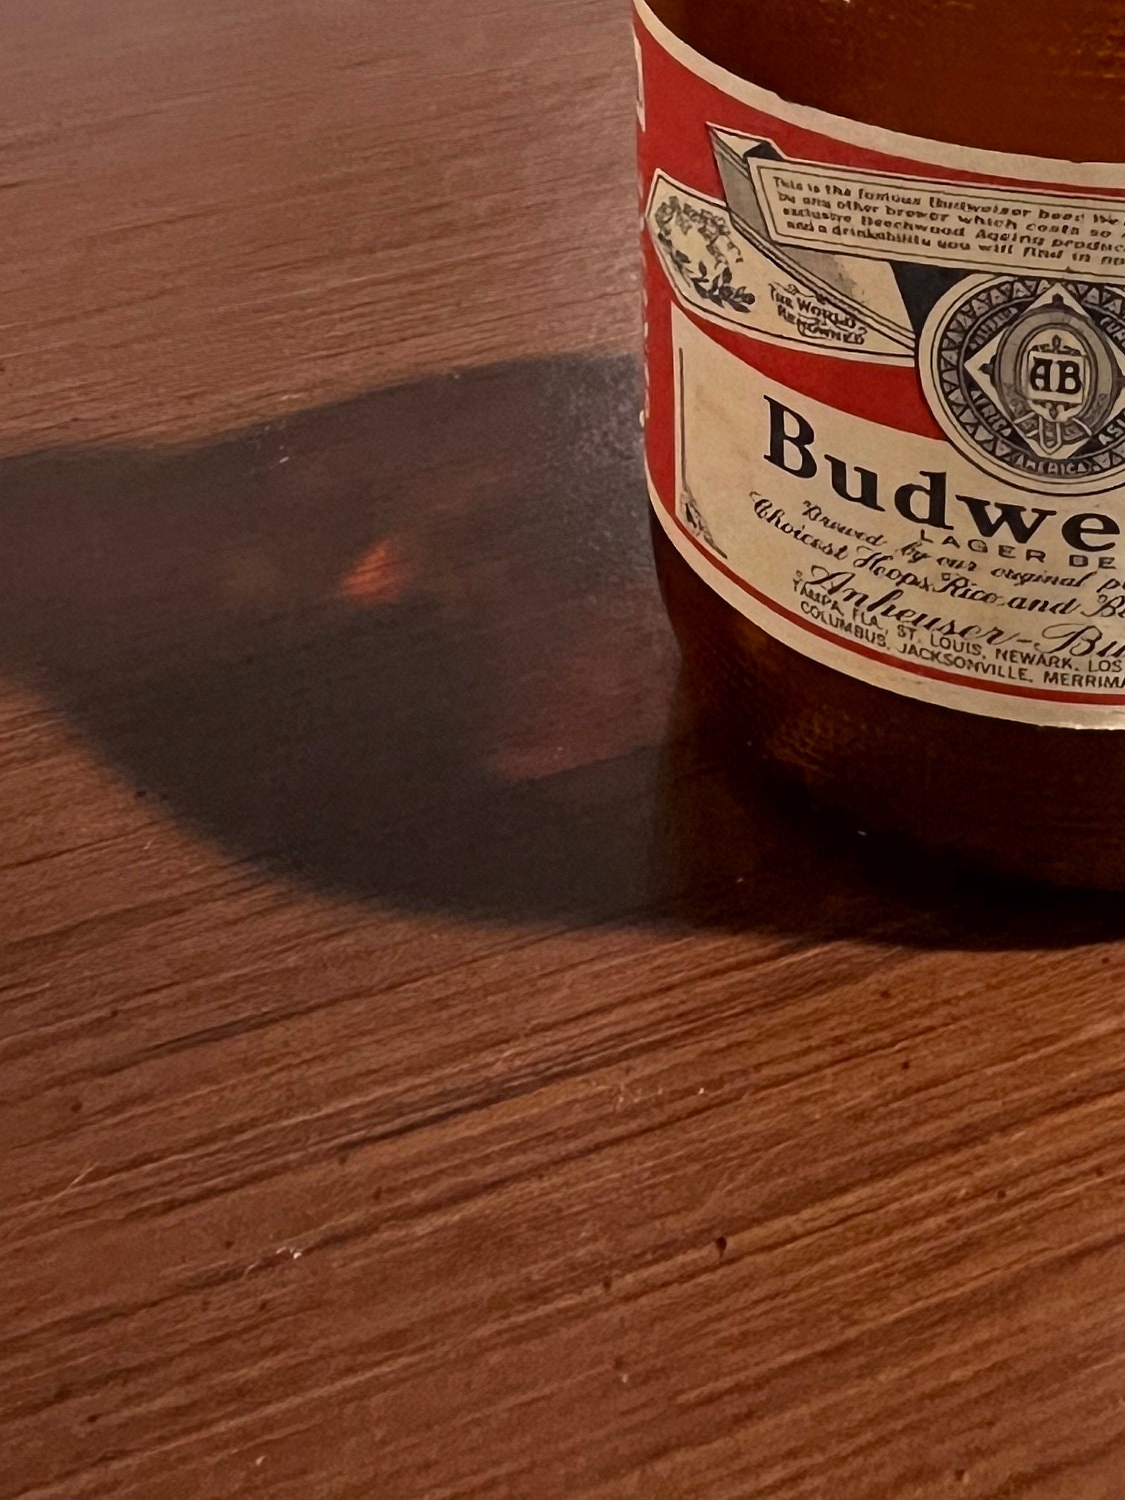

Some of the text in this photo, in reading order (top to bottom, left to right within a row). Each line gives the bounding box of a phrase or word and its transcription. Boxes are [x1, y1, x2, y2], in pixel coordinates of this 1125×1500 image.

[825, 184, 851, 197] the
[858, 188, 921, 206] famous
[837, 199, 880, 214] other
[885, 205, 950, 222] brewer
[958, 214, 1018, 231] which
[861, 216, 965, 237] Beechwood
[818, 224, 828, 234] a
[978, 243, 1013, 255] will
[1023, 246, 1064, 260] find
[1072, 251, 1091, 263] in
[1101, 255, 1125, 266] no
[801, 500, 888, 546] Brewed
[895, 541, 932, 564] by
[936, 556, 977, 572] our
[991, 566, 1097, 588] original
[920, 529, 1047, 563] LAGER
[1088, 657, 1123, 672] LOS
